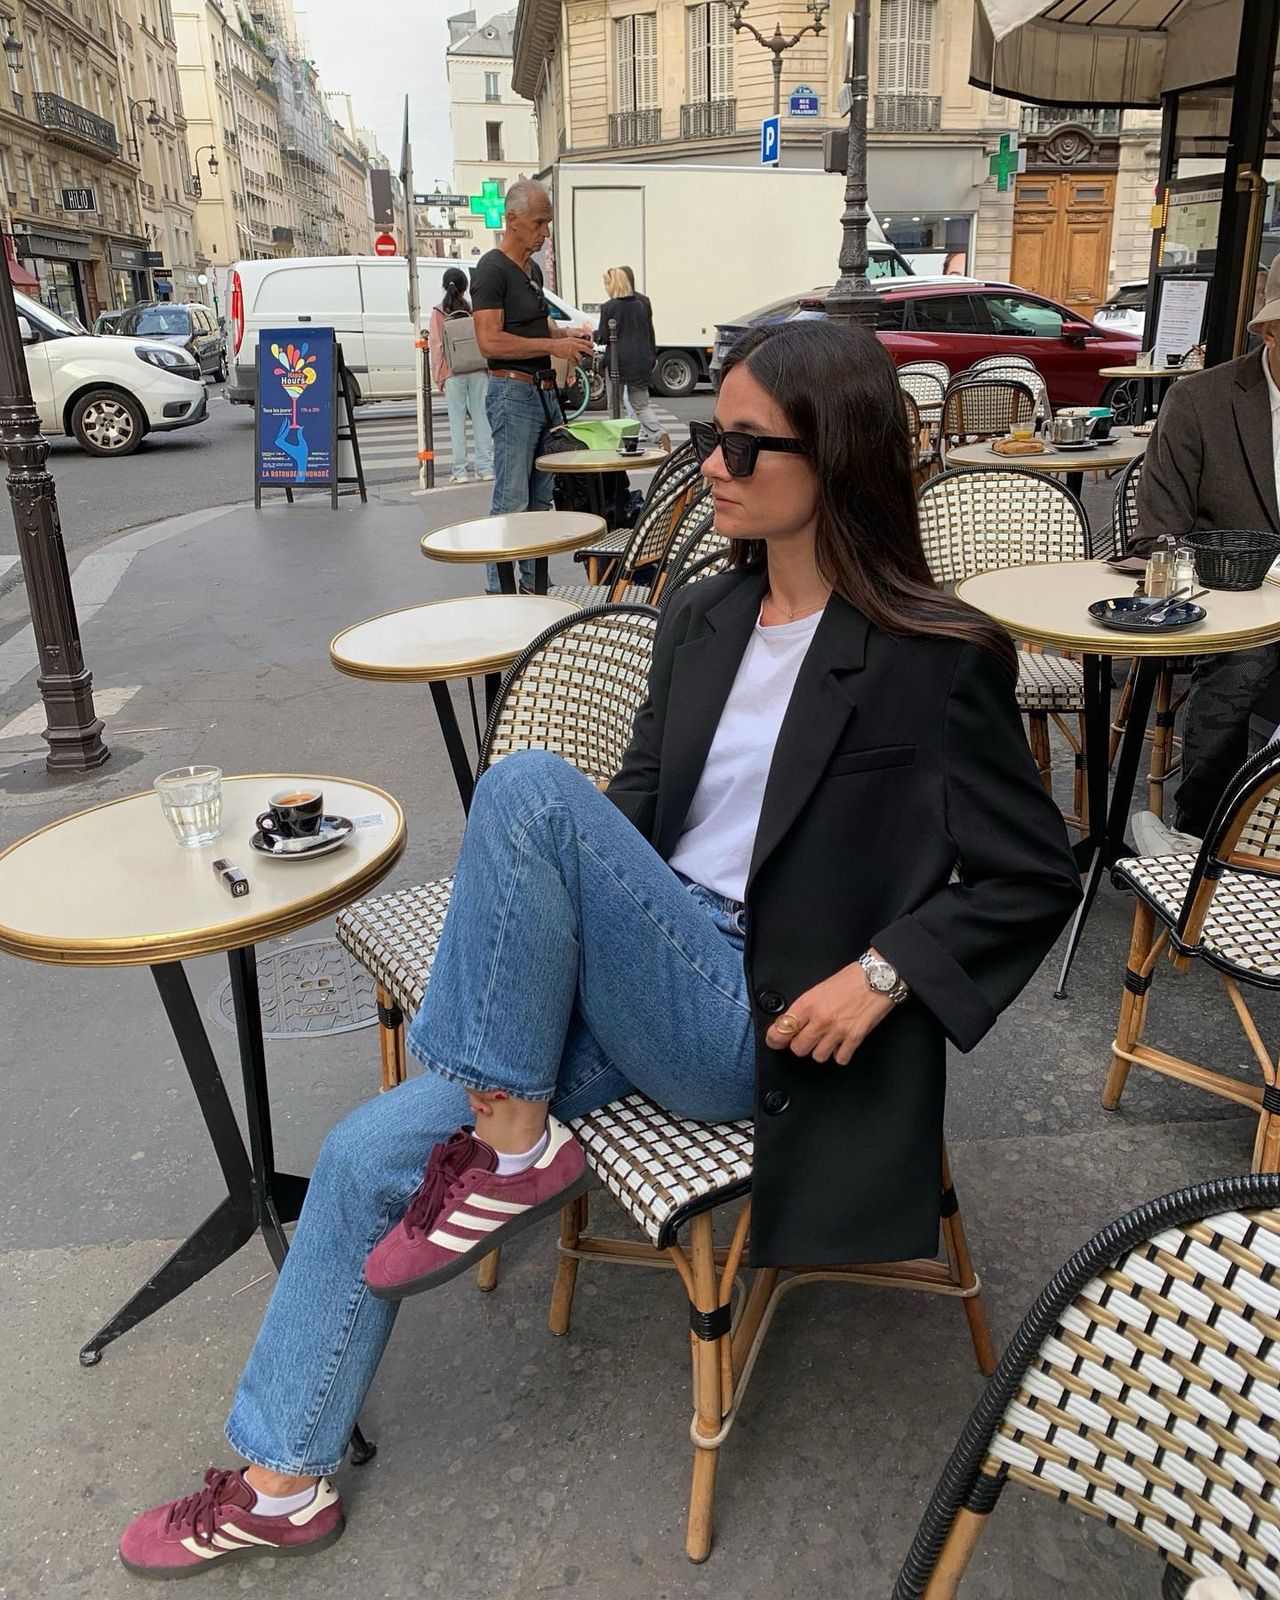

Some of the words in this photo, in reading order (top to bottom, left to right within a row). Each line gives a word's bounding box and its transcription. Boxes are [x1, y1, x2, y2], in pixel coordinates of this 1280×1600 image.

[766, 126, 775, 155] P
[281, 377, 305, 385] Hours
[305, 469, 329, 477] HONORÉ
